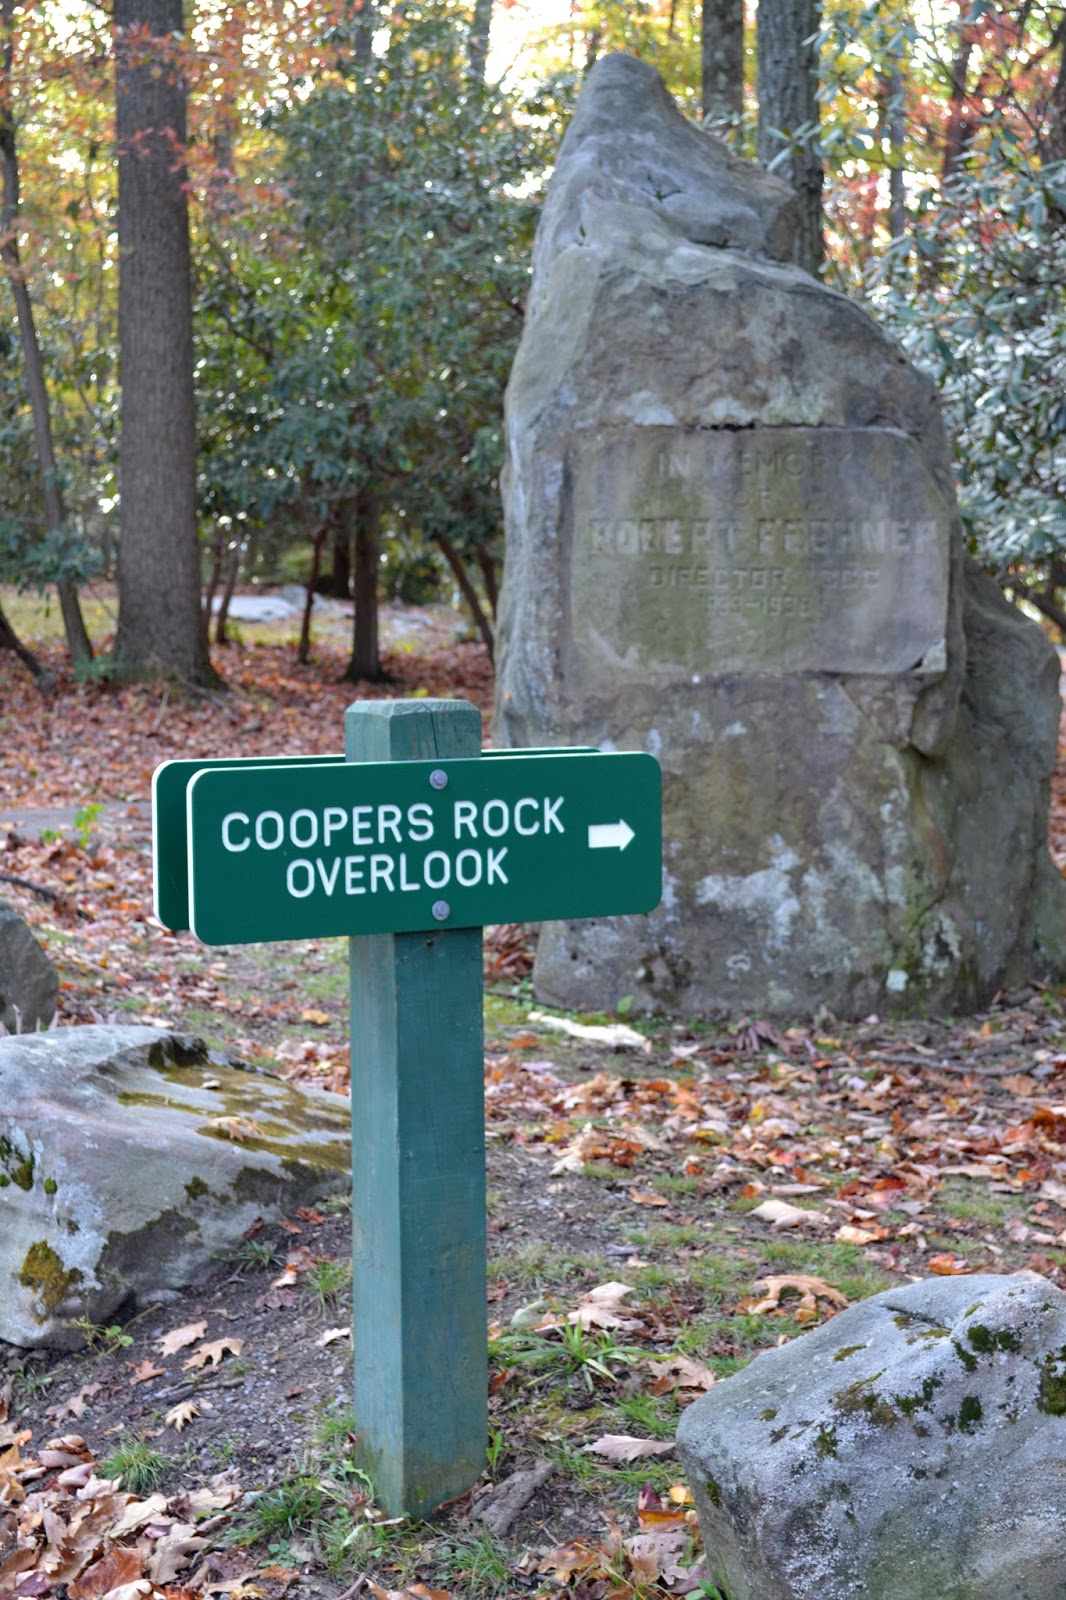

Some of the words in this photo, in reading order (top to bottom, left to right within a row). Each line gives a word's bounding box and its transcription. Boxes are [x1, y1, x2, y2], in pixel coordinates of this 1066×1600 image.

[658, 452, 691, 479] IN
[711, 452, 853, 480] MEMORY
[221, 803, 435, 852] COOPERS
[454, 796, 565, 840] ROCK
[286, 846, 509, 898] OVERLOOK
